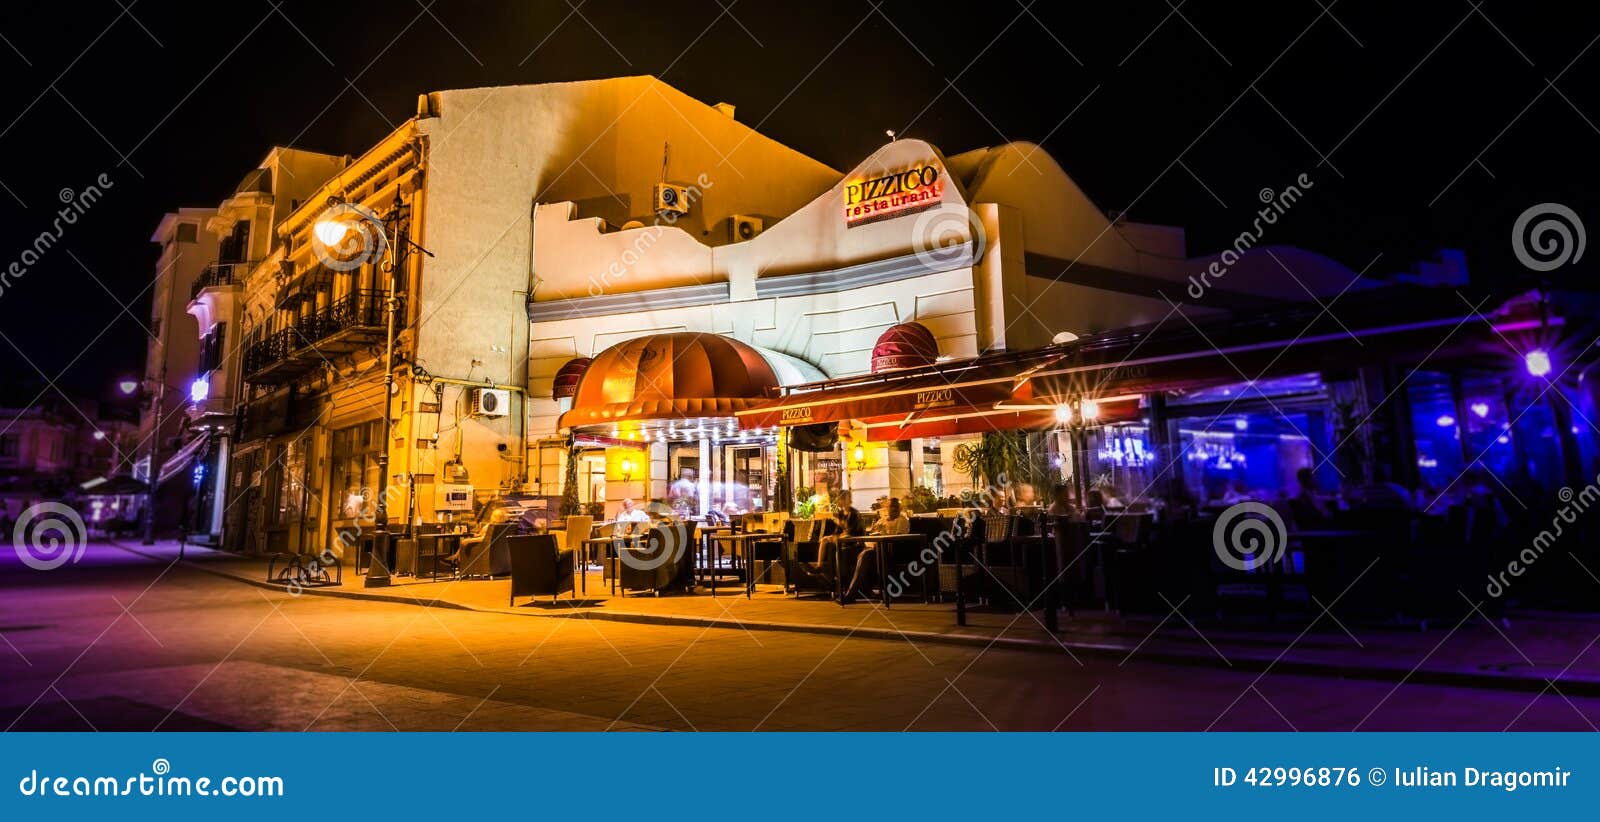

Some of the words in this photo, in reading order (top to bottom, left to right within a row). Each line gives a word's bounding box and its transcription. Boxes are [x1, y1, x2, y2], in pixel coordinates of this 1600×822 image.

[846, 165, 938, 206] PIZZICO
[846, 185, 940, 217] restaurant
[917, 388, 952, 404] PIZZICO
[782, 406, 811, 420] PIZZICO
